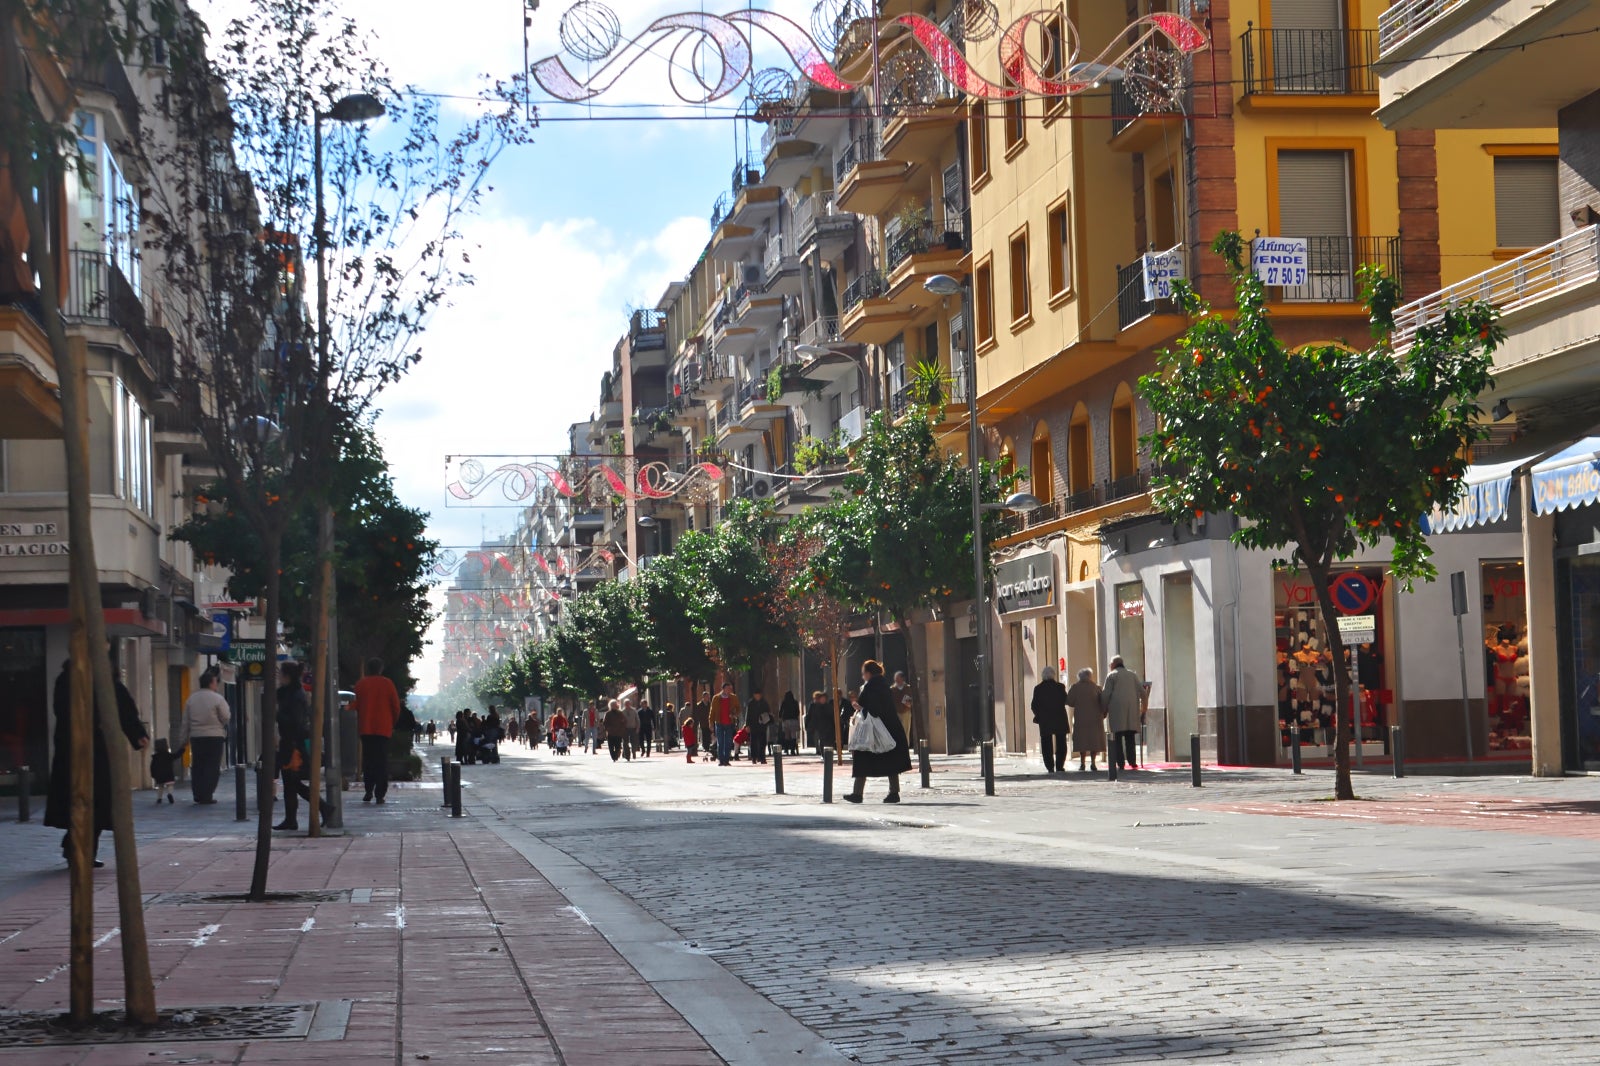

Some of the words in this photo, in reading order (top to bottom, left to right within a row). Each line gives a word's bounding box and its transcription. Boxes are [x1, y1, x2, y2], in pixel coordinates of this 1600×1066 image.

[1268, 267, 1278, 284] 27
[1282, 267, 1292, 284] 50
[1296, 268, 1305, 284] 57
[34, 523, 56, 535] DE
[0, 543, 70, 555] LACION
